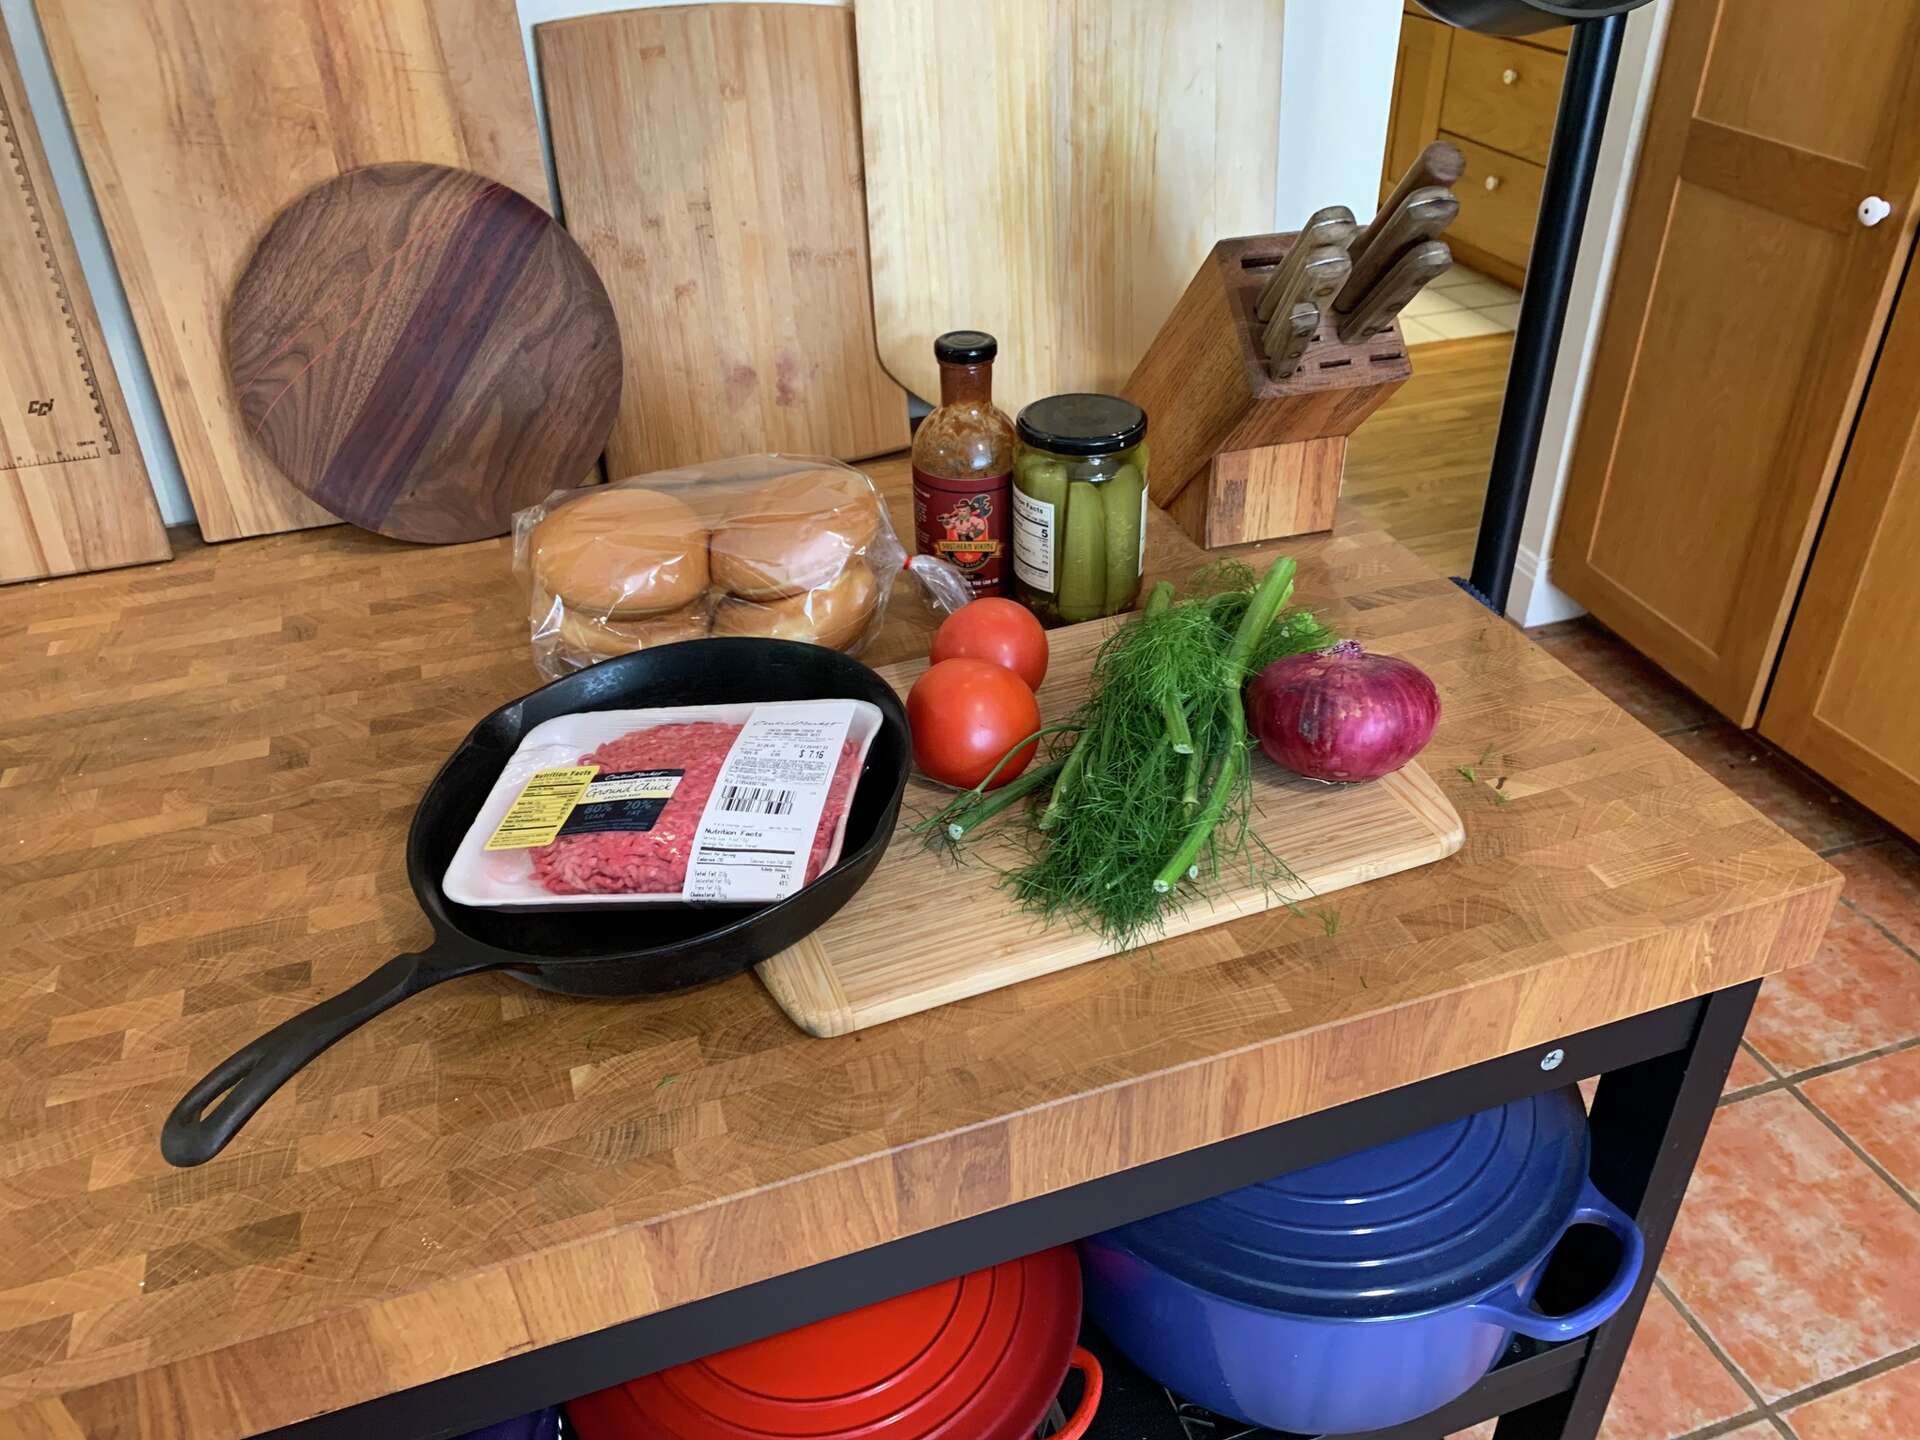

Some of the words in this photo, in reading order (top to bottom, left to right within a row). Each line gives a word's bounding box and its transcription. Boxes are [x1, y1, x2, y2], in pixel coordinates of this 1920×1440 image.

[1026, 502, 1043, 514] Facts
[1041, 529, 1049, 538] 5
[809, 750, 825, 759] 7.16
[535, 771, 568, 779] Nutrition
[571, 769, 592, 777] Facts
[586, 784, 631, 798] Ground
[634, 781, 671, 792] Chuck
[583, 803, 612, 815] 80%
[623, 800, 652, 811] 20%
[704, 828, 737, 836] Nutrition
